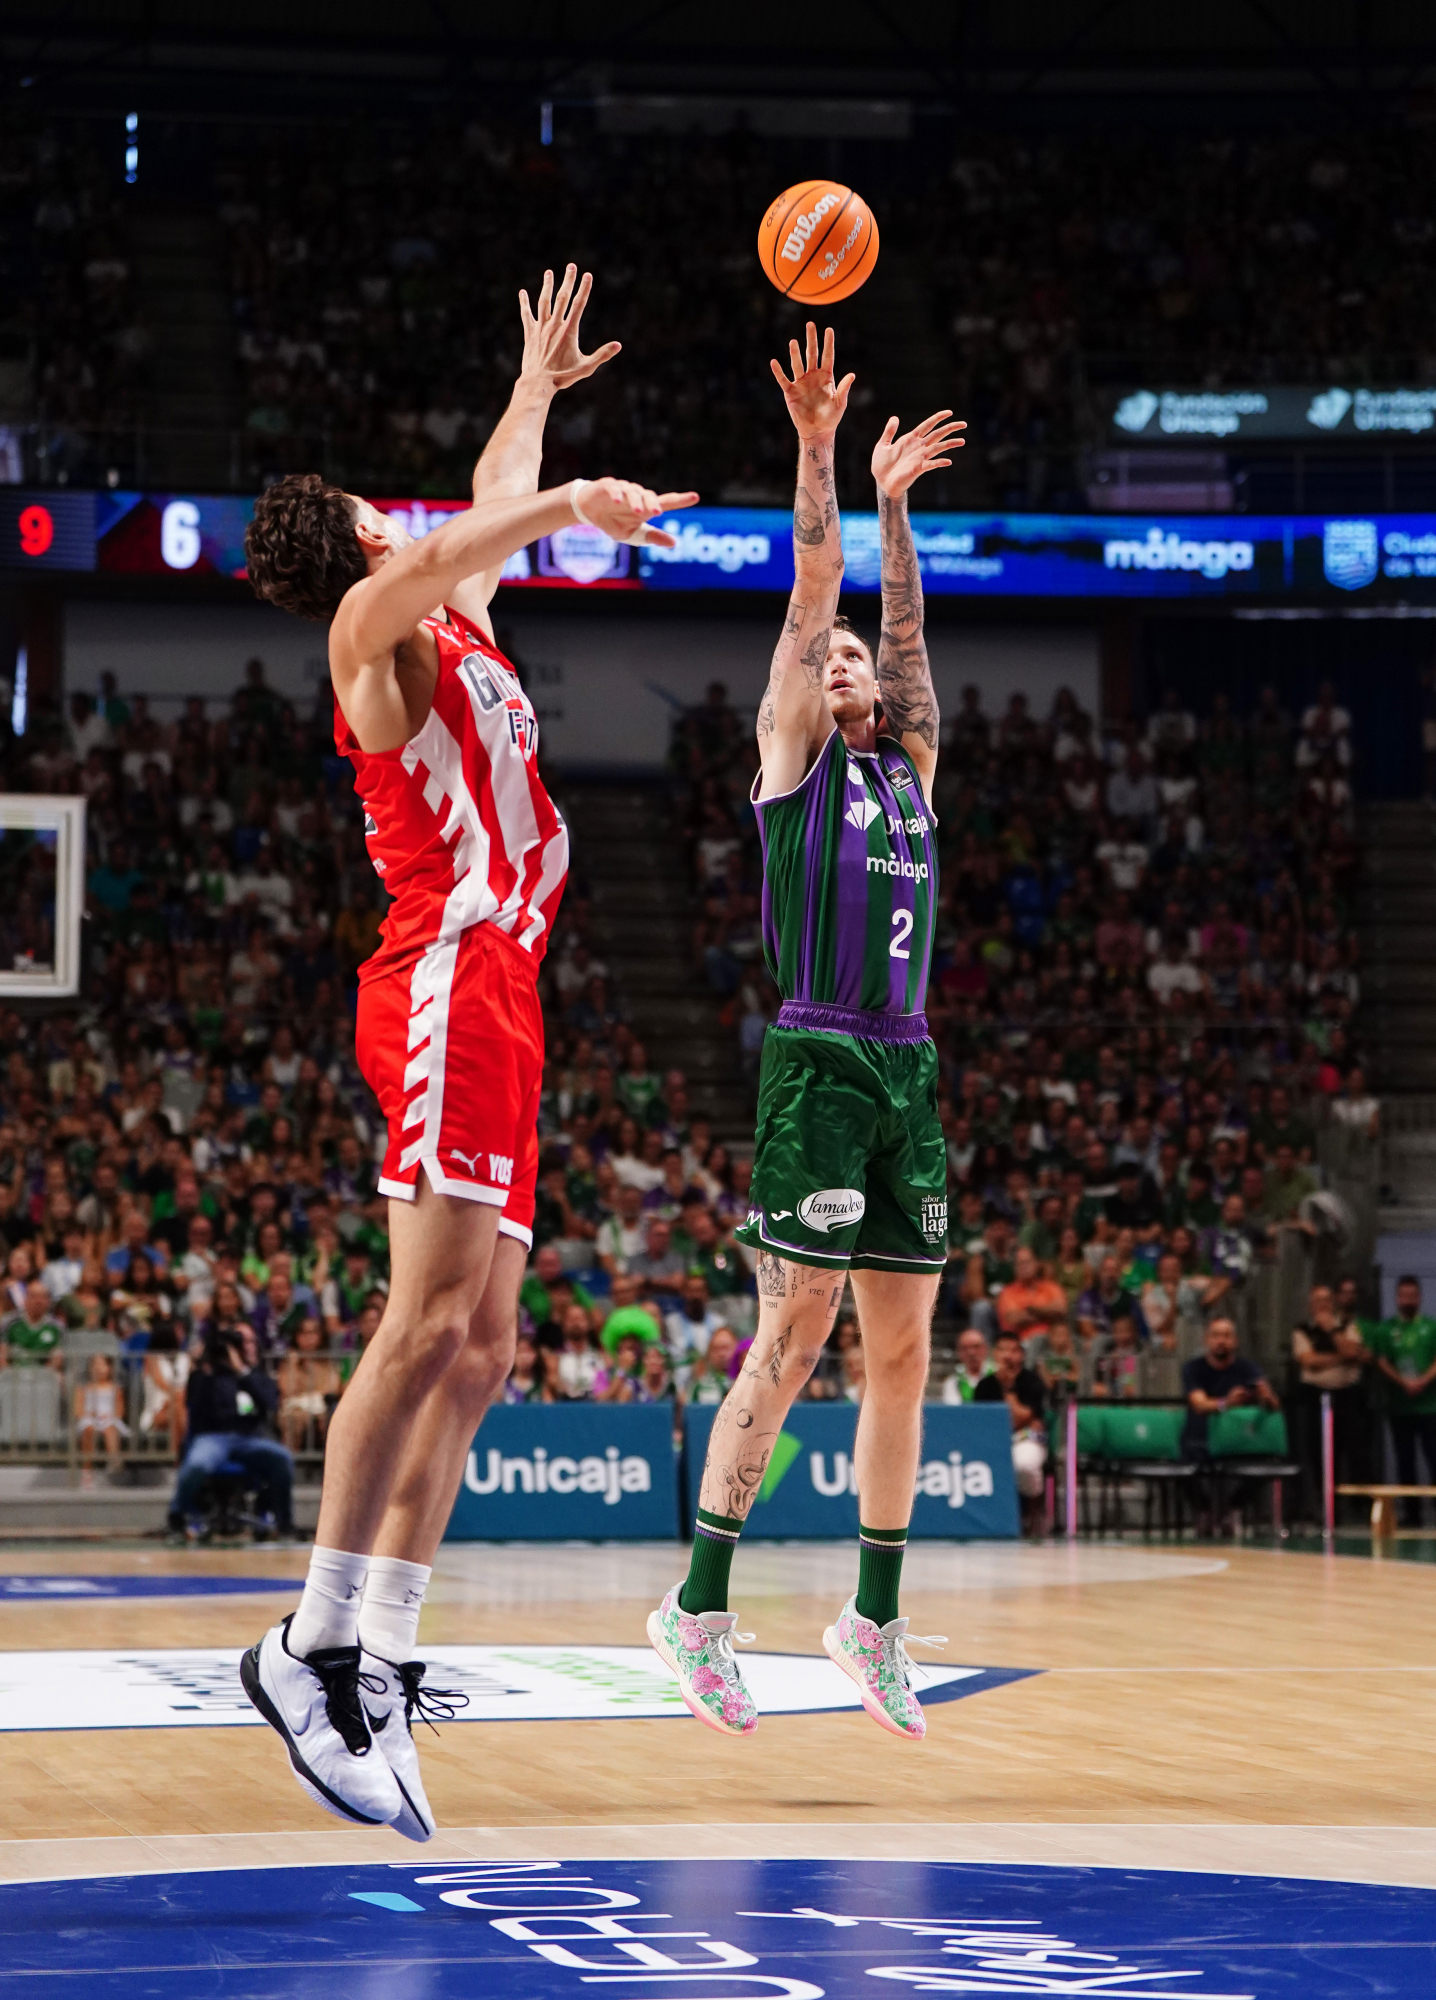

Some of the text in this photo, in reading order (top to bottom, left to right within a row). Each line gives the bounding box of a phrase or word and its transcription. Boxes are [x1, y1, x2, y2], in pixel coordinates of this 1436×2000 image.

[781, 193, 841, 263] Wilson
[18, 505, 54, 556] 9
[161, 500, 200, 570] 6
[889, 908, 914, 960] 2
[921, 1194, 940, 1204] sabor
[464, 1446, 651, 1505] Unicaja
